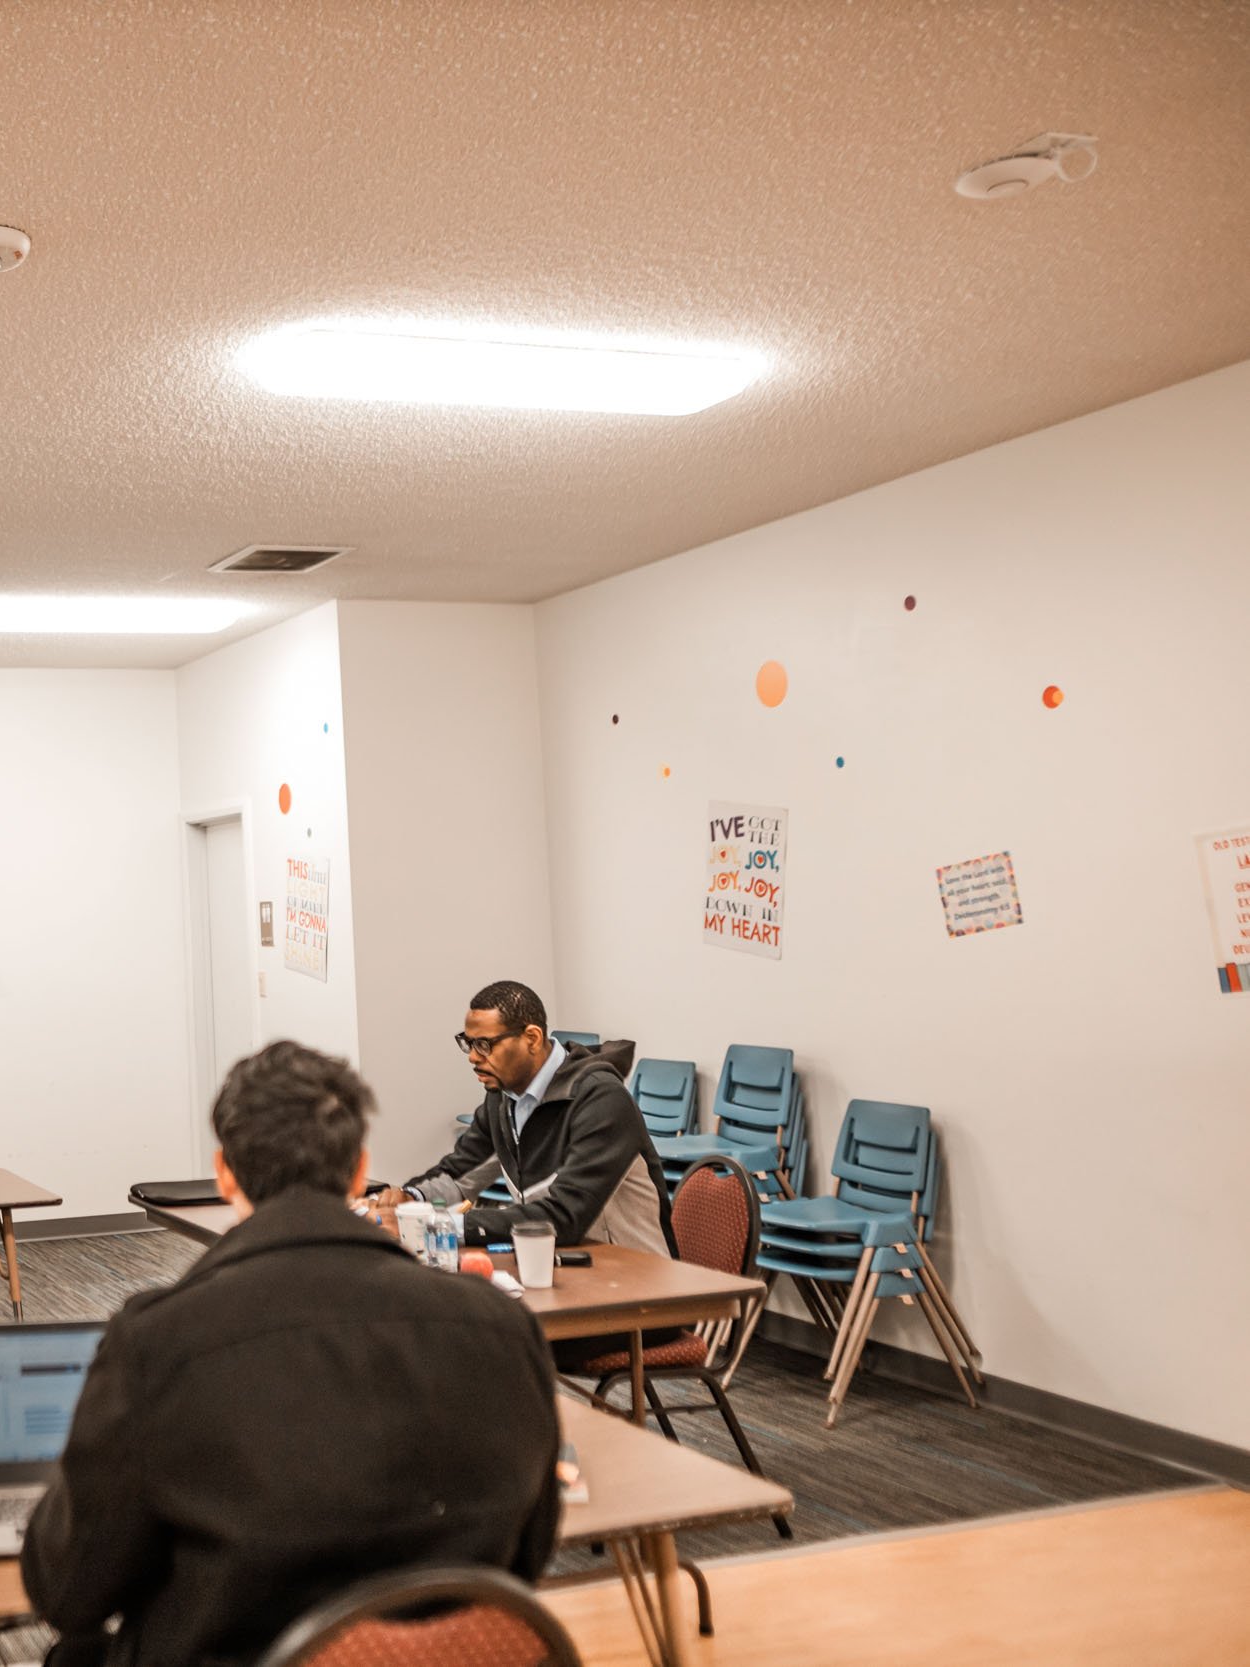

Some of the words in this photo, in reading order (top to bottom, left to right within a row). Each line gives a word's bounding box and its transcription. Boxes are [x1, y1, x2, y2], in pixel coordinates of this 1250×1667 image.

[710, 815, 745, 842] I'VE
[749, 815, 782, 832] GOT
[287, 858, 309, 880] THIS
[744, 850, 780, 873] JOY,
[708, 869, 741, 892] JOY,
[744, 877, 780, 908] JOY,
[298, 911, 327, 934] GONNA
[704, 911, 726, 935] MY
[731, 917, 781, 947] HEART
